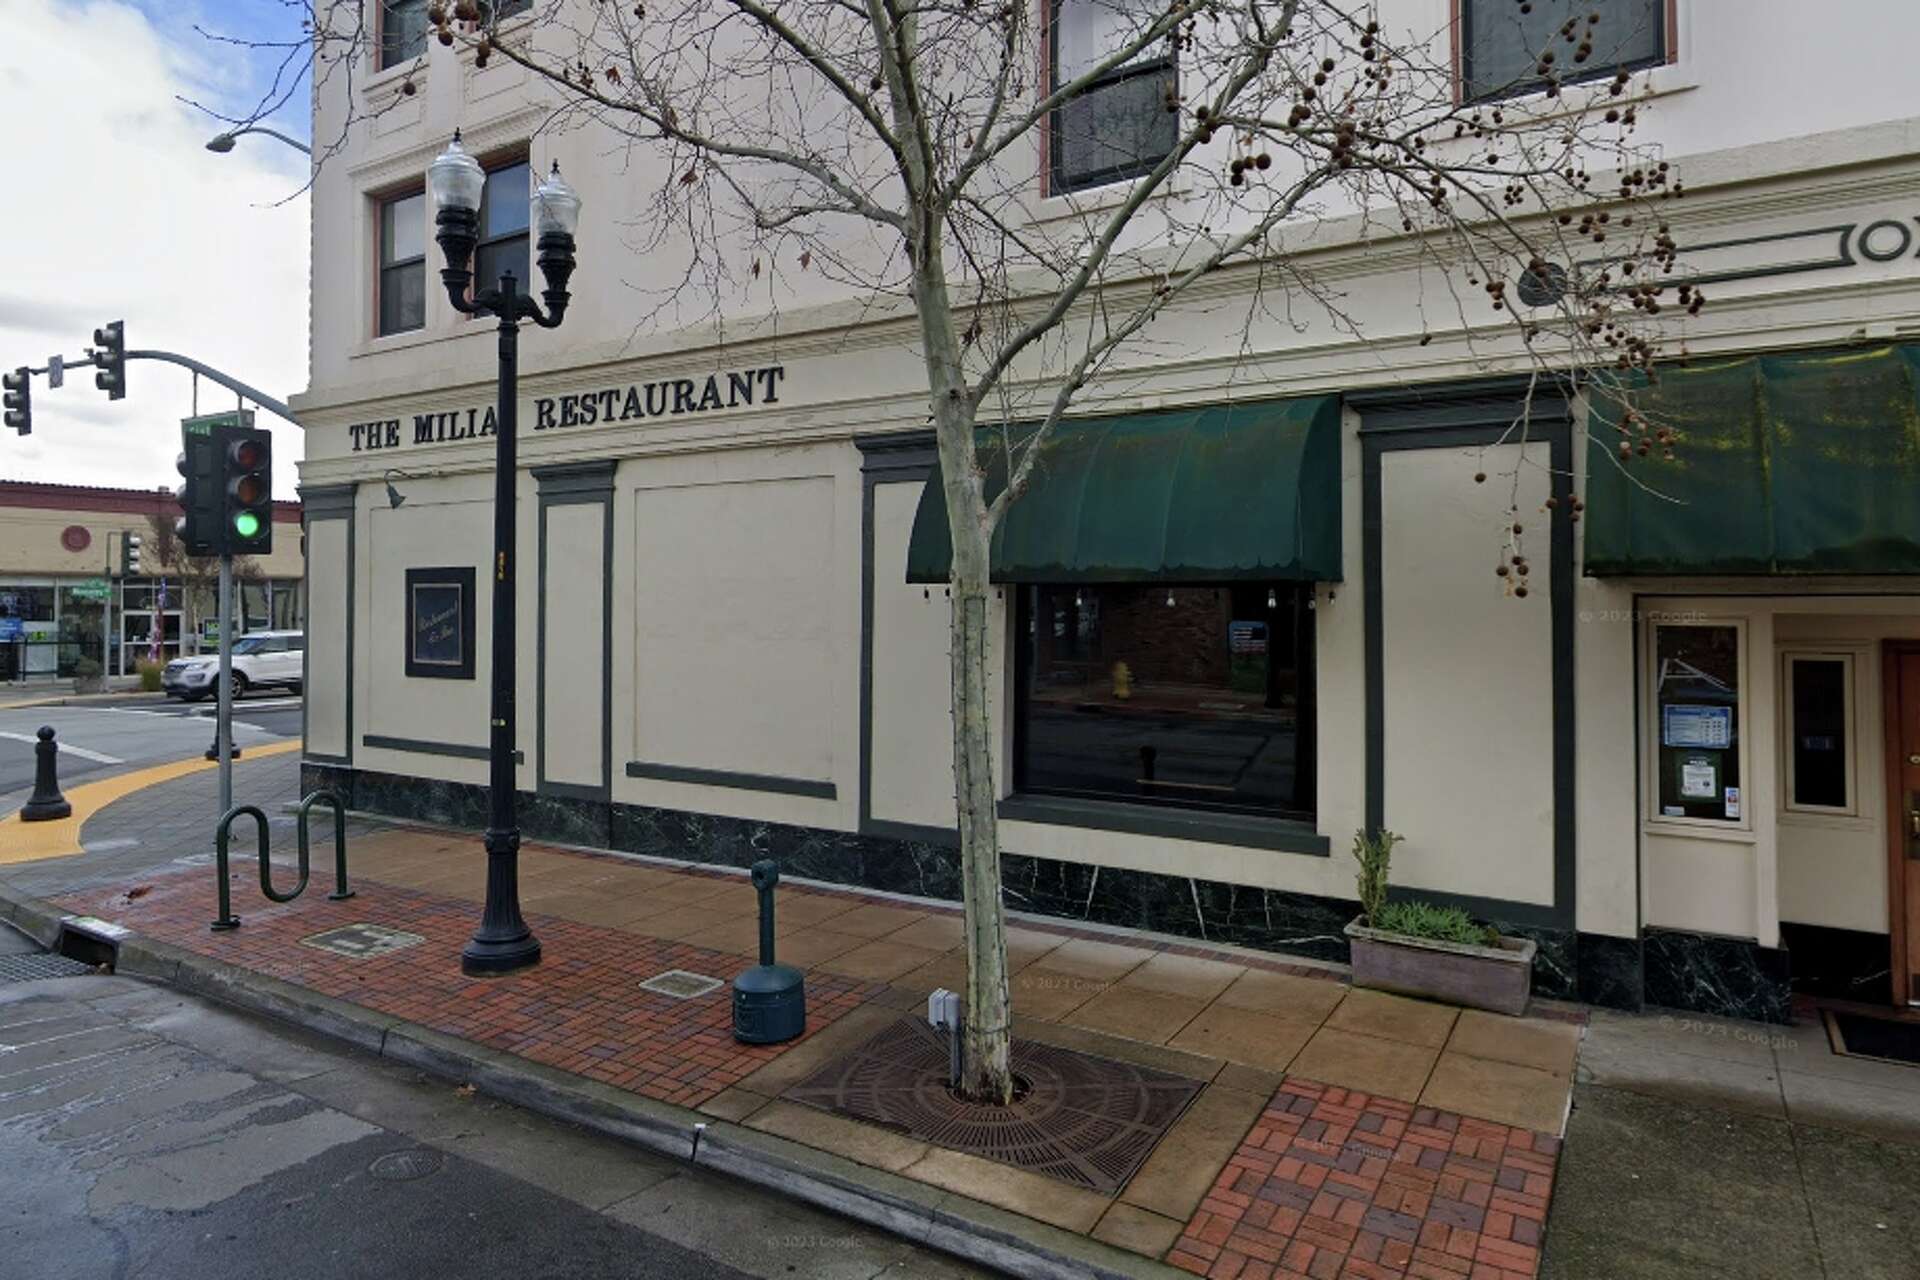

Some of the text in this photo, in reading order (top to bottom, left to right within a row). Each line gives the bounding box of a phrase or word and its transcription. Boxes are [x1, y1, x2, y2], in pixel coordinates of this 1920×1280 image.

[1857, 217, 1920, 262] O
[349, 365, 784, 452] THE MILIA RESTAURANT
